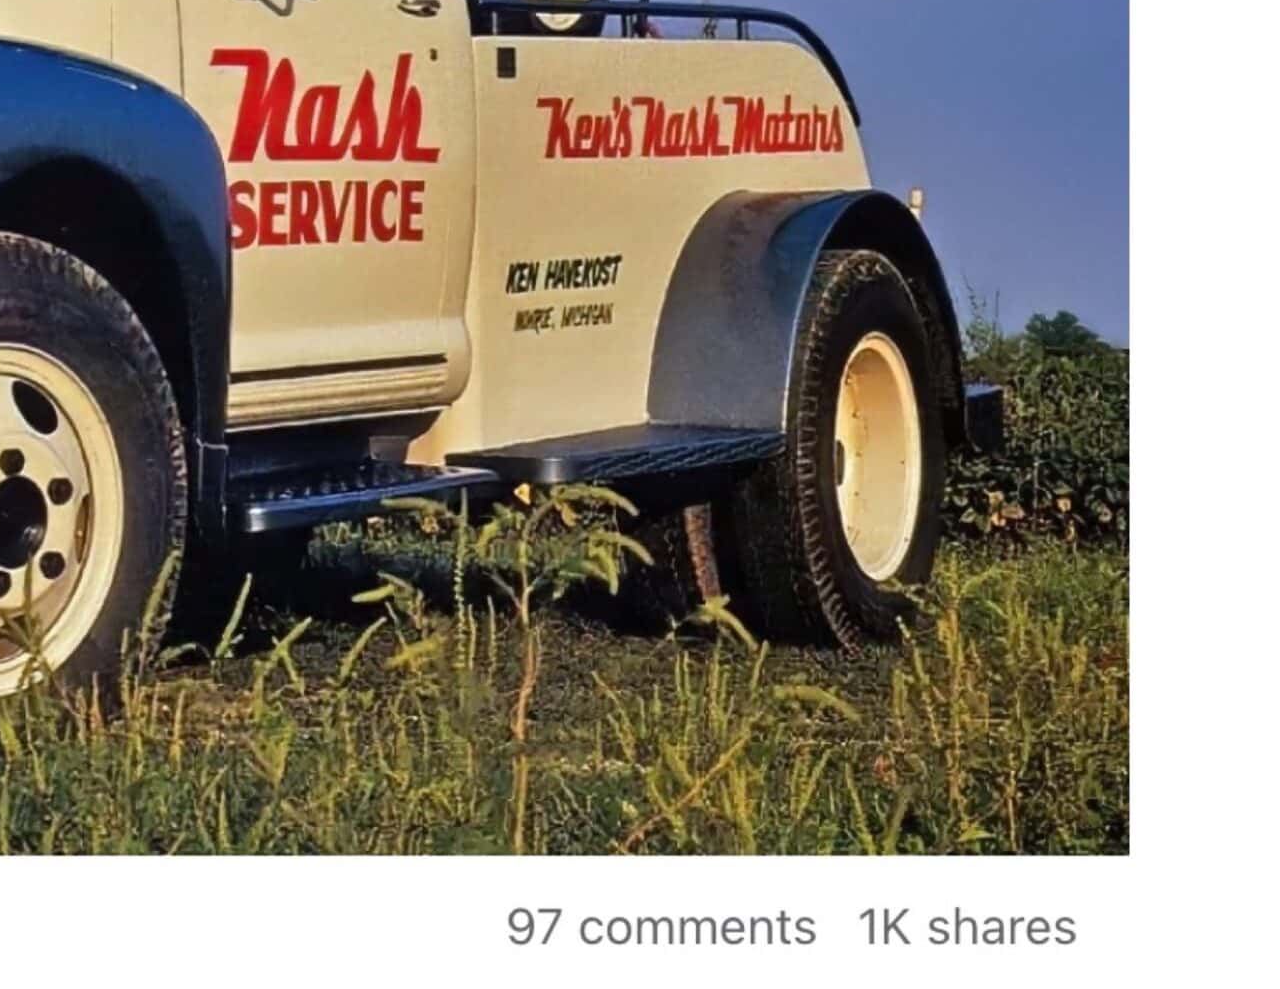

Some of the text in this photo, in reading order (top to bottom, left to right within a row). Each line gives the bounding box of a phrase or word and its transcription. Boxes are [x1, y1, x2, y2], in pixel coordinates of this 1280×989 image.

[210, 46, 441, 164] Nash
[536, 93, 845, 159] Ken's Nash Motors
[228, 178, 426, 251] SERVICE
[505, 254, 623, 294] KEN HAVEKOST
